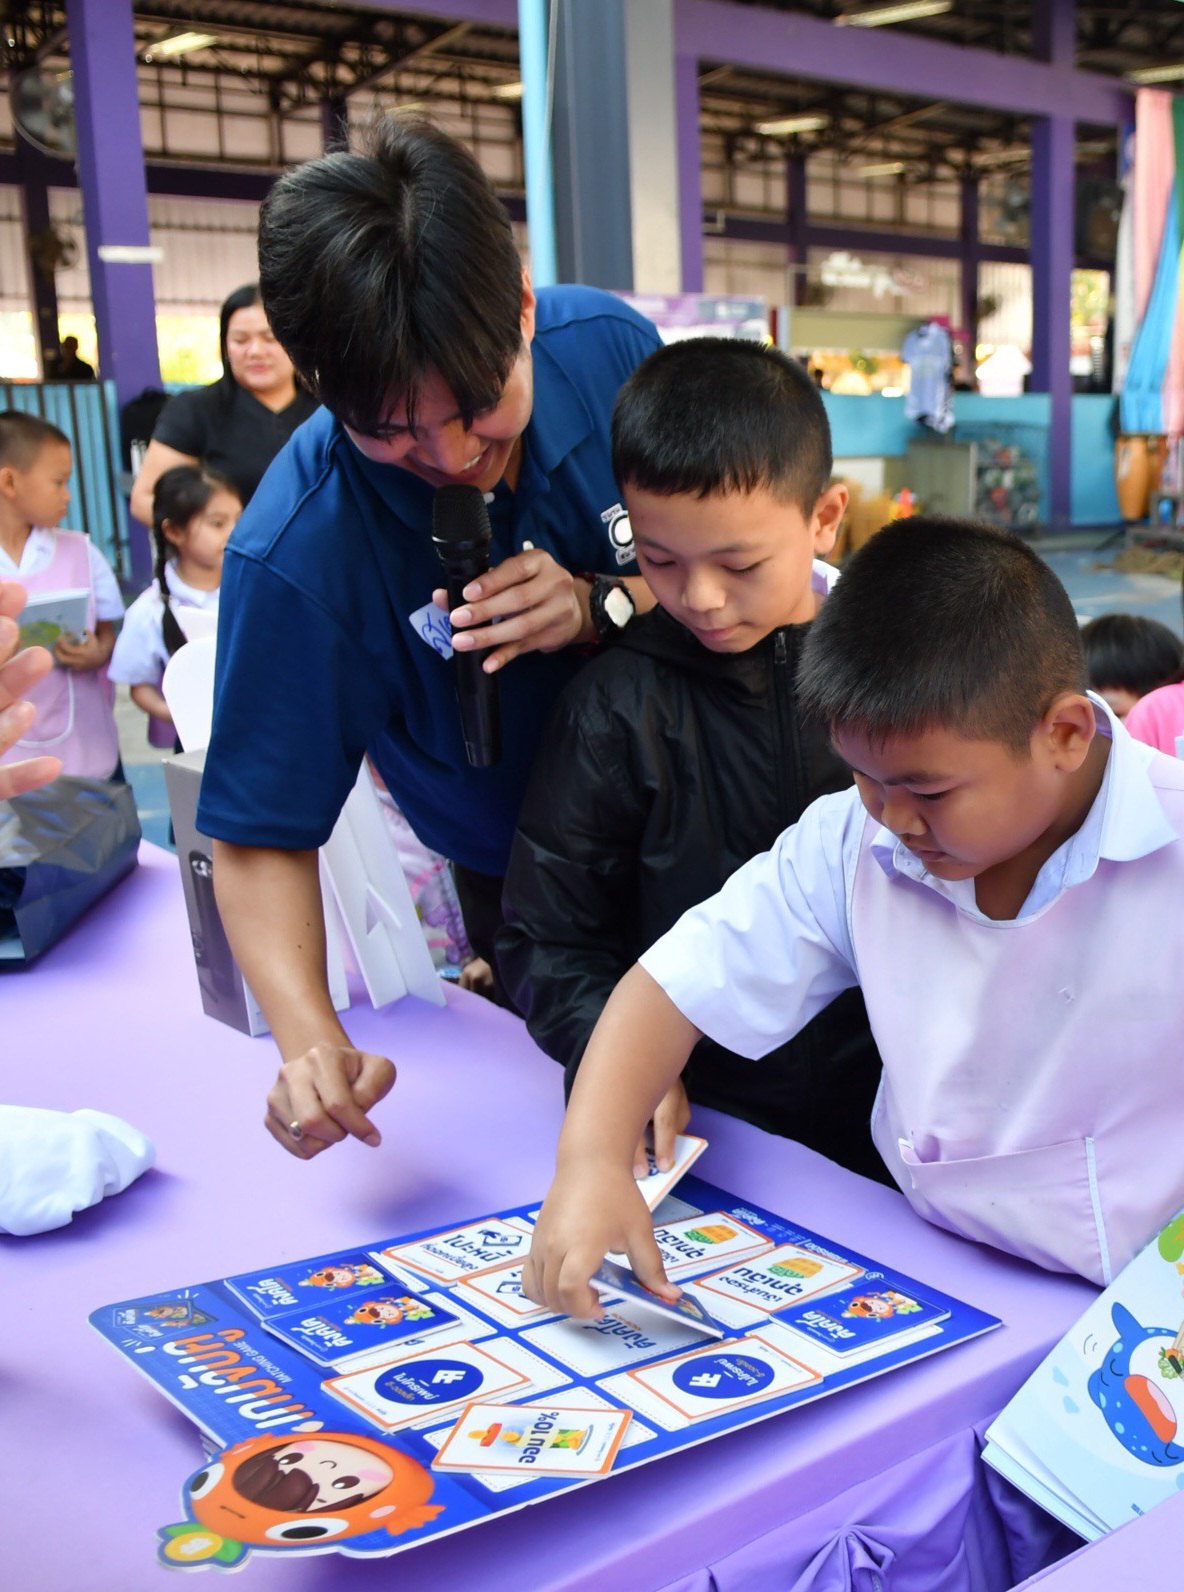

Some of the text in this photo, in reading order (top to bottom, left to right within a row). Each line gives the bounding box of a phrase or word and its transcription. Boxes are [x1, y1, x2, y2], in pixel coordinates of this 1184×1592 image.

[443, 1233, 513, 1262] โปะหนี้
[718, 1275, 783, 1303] เงินสำรอง
[733, 1267, 803, 1296] ฉุกเฉิน
[233, 1341, 293, 1383] MATCHING GAME
[136, 1328, 315, 1430] เกมจับคู่
